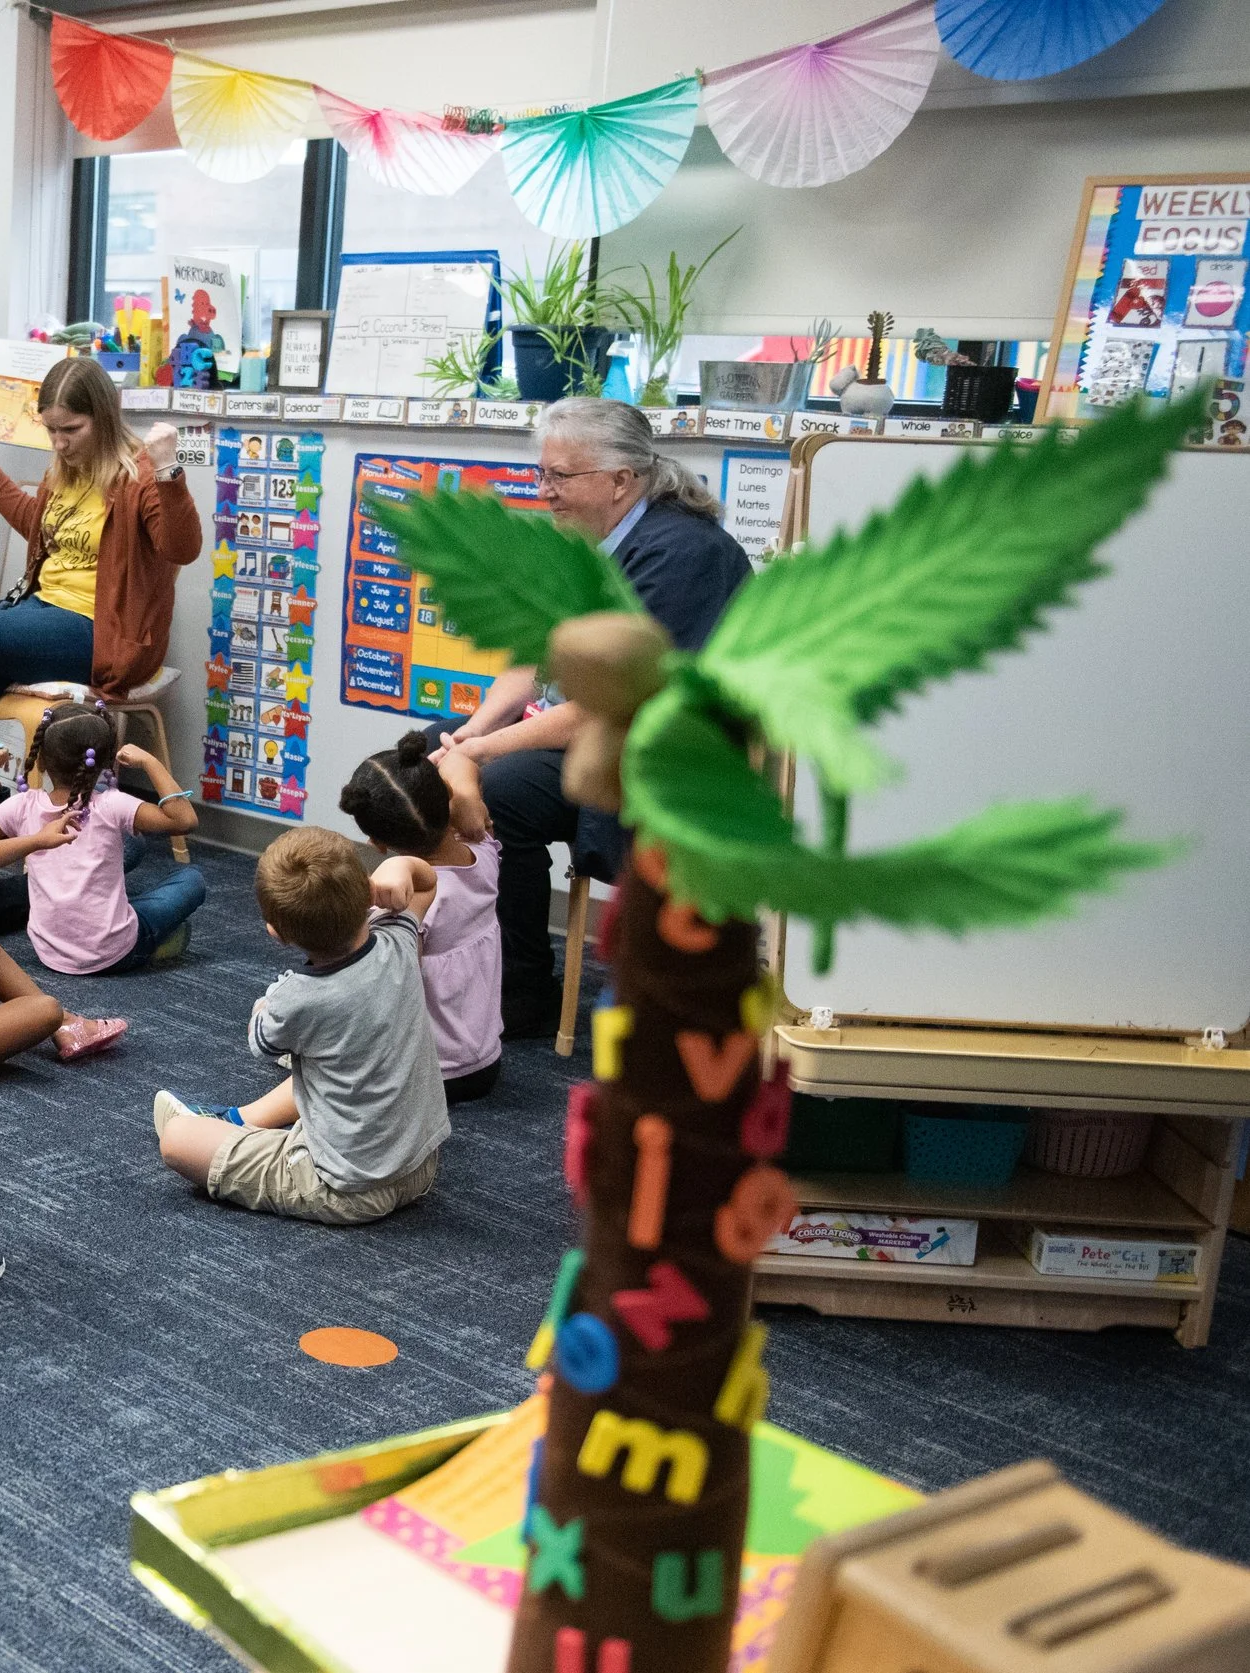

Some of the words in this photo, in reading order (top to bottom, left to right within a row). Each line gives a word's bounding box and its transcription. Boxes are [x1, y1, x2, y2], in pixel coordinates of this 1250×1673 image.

[1142, 190, 1250, 217] WEEKL
[1141, 227, 1243, 252] FOCUS
[1209, 263, 1235, 271] circle
[173, 264, 226, 288] WORRYSAURUS
[372, 318, 408, 334] Coconut
[411, 318, 419, 334] 5
[180, 392, 202, 402] Morning
[179, 402, 201, 412] Meeting
[227, 400, 263, 411] Centers
[285, 403, 323, 413] Calendar
[352, 400, 370, 408] Read
[421, 402, 442, 411] Small
[350, 411, 370, 419] Aloud
[419, 413, 441, 423] Group
[478, 407, 519, 420] Outside
[706, 417, 731, 430] Rest
[733, 418, 762, 431] Time
[800, 419, 840, 433] Snack
[900, 420, 931, 432] Whole
[175, 438, 210, 448] ssroom
[215, 439, 242, 449] Aaliyah
[295, 444, 325, 452] Ramiro
[175, 451, 206, 464] OBS
[439, 462, 464, 472] Season
[506, 467, 530, 477] Month
[739, 464, 783, 478] Domingo
[271, 478, 296, 499] 123
[374, 485, 406, 501] January
[493, 483, 539, 497] Septembe
[738, 482, 767, 493] Lunes
[736, 499, 770, 510] Martes
[213, 514, 239, 523] Leilani
[735, 516, 781, 529] Miercoles
[376, 542, 397, 554] April
[373, 564, 391, 576] May
[370, 585, 391, 597] June
[287, 597, 316, 608] Gunner
[373, 600, 391, 612] July
[366, 613, 396, 627] August
[419, 609, 433, 624] 18
[212, 629, 229, 638] Zara
[284, 636, 313, 645] Octavia
[357, 649, 391, 663] October
[208, 663, 229, 674] Kylee
[356, 663, 393, 678] November
[356, 677, 394, 692] December
[420, 696, 441, 708] sunny
[453, 701, 476, 713] windy
[202, 736, 228, 749] Aaliyah
[284, 752, 305, 762] Nasir
[279, 785, 305, 798] Joseph
[796, 1226, 863, 1244] COLORATIONS
[868, 1231, 899, 1240] Washable
[899, 1233, 922, 1242] Chubby
[877, 1238, 912, 1247] MARKERS
[1081, 1246, 1112, 1260] Pete
[1121, 1250, 1148, 1263] Cat
